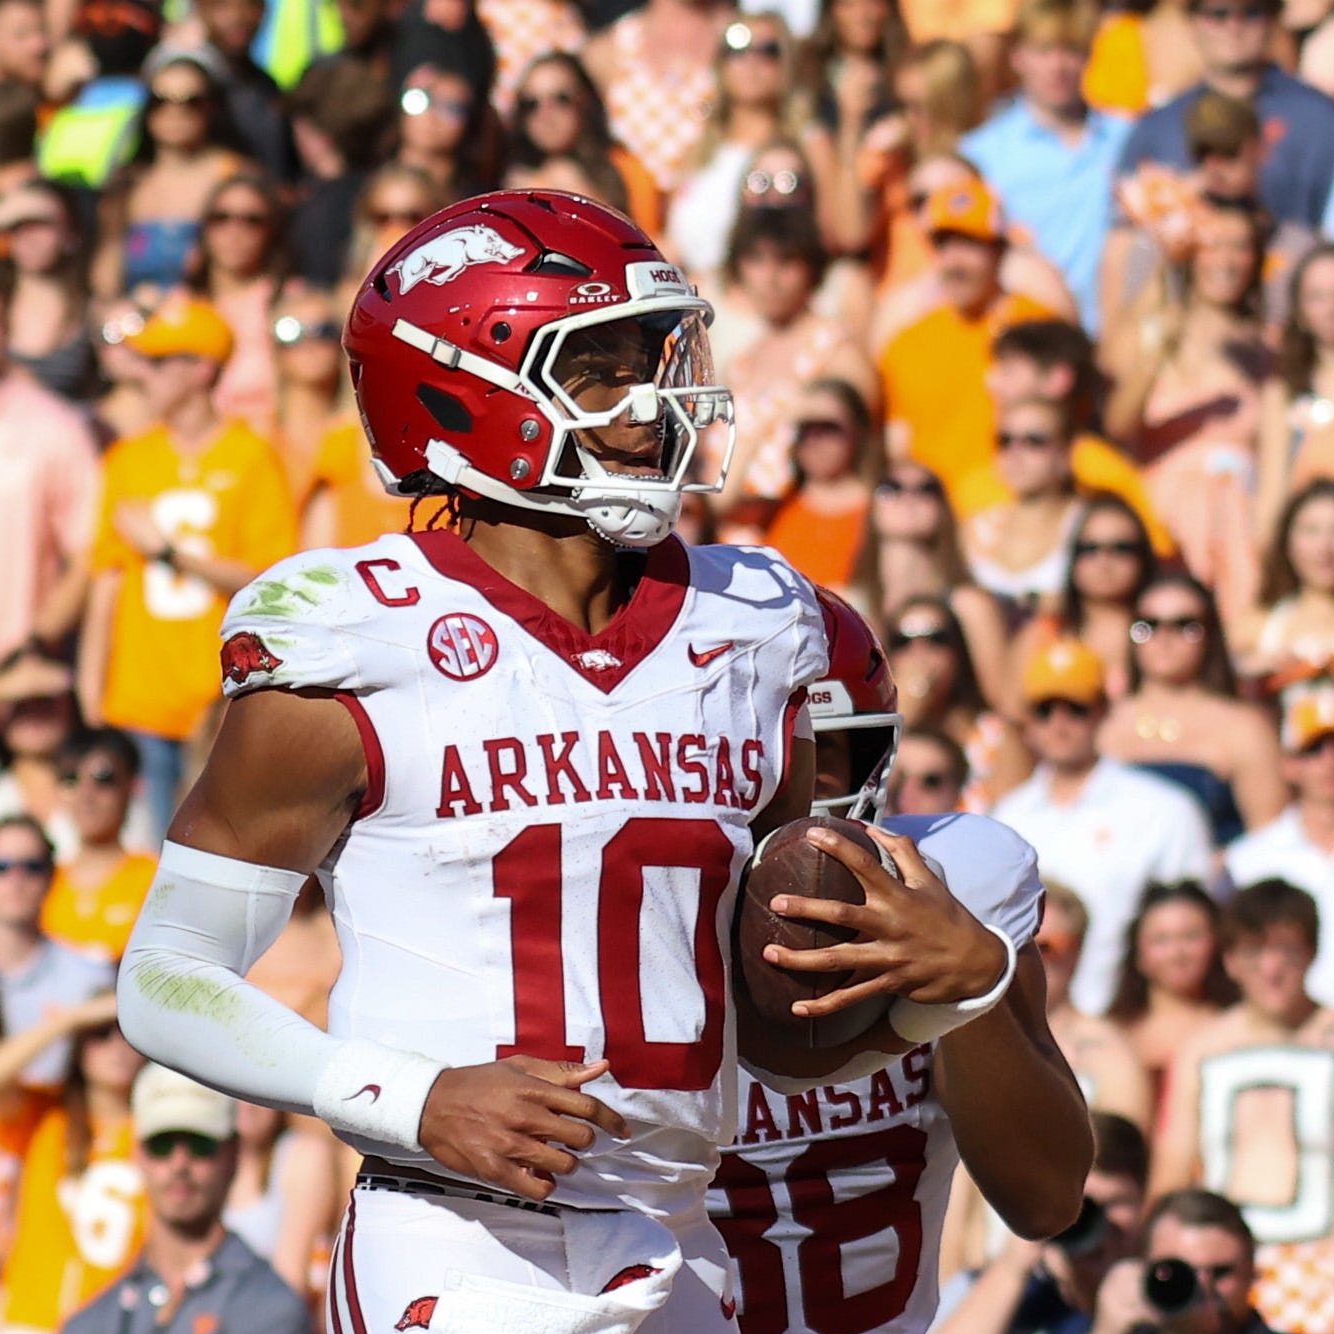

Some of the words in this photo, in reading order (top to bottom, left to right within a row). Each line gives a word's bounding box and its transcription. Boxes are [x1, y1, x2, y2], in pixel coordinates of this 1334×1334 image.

[569, 294, 620, 304] OAKLEY
[355, 558, 421, 607] C
[431, 616, 493, 677] SEC
[806, 691, 832, 704] GS
[436, 730, 764, 818] ARKANSAS
[492, 817, 734, 1092] 10
[733, 1042, 933, 1146] ANSAS
